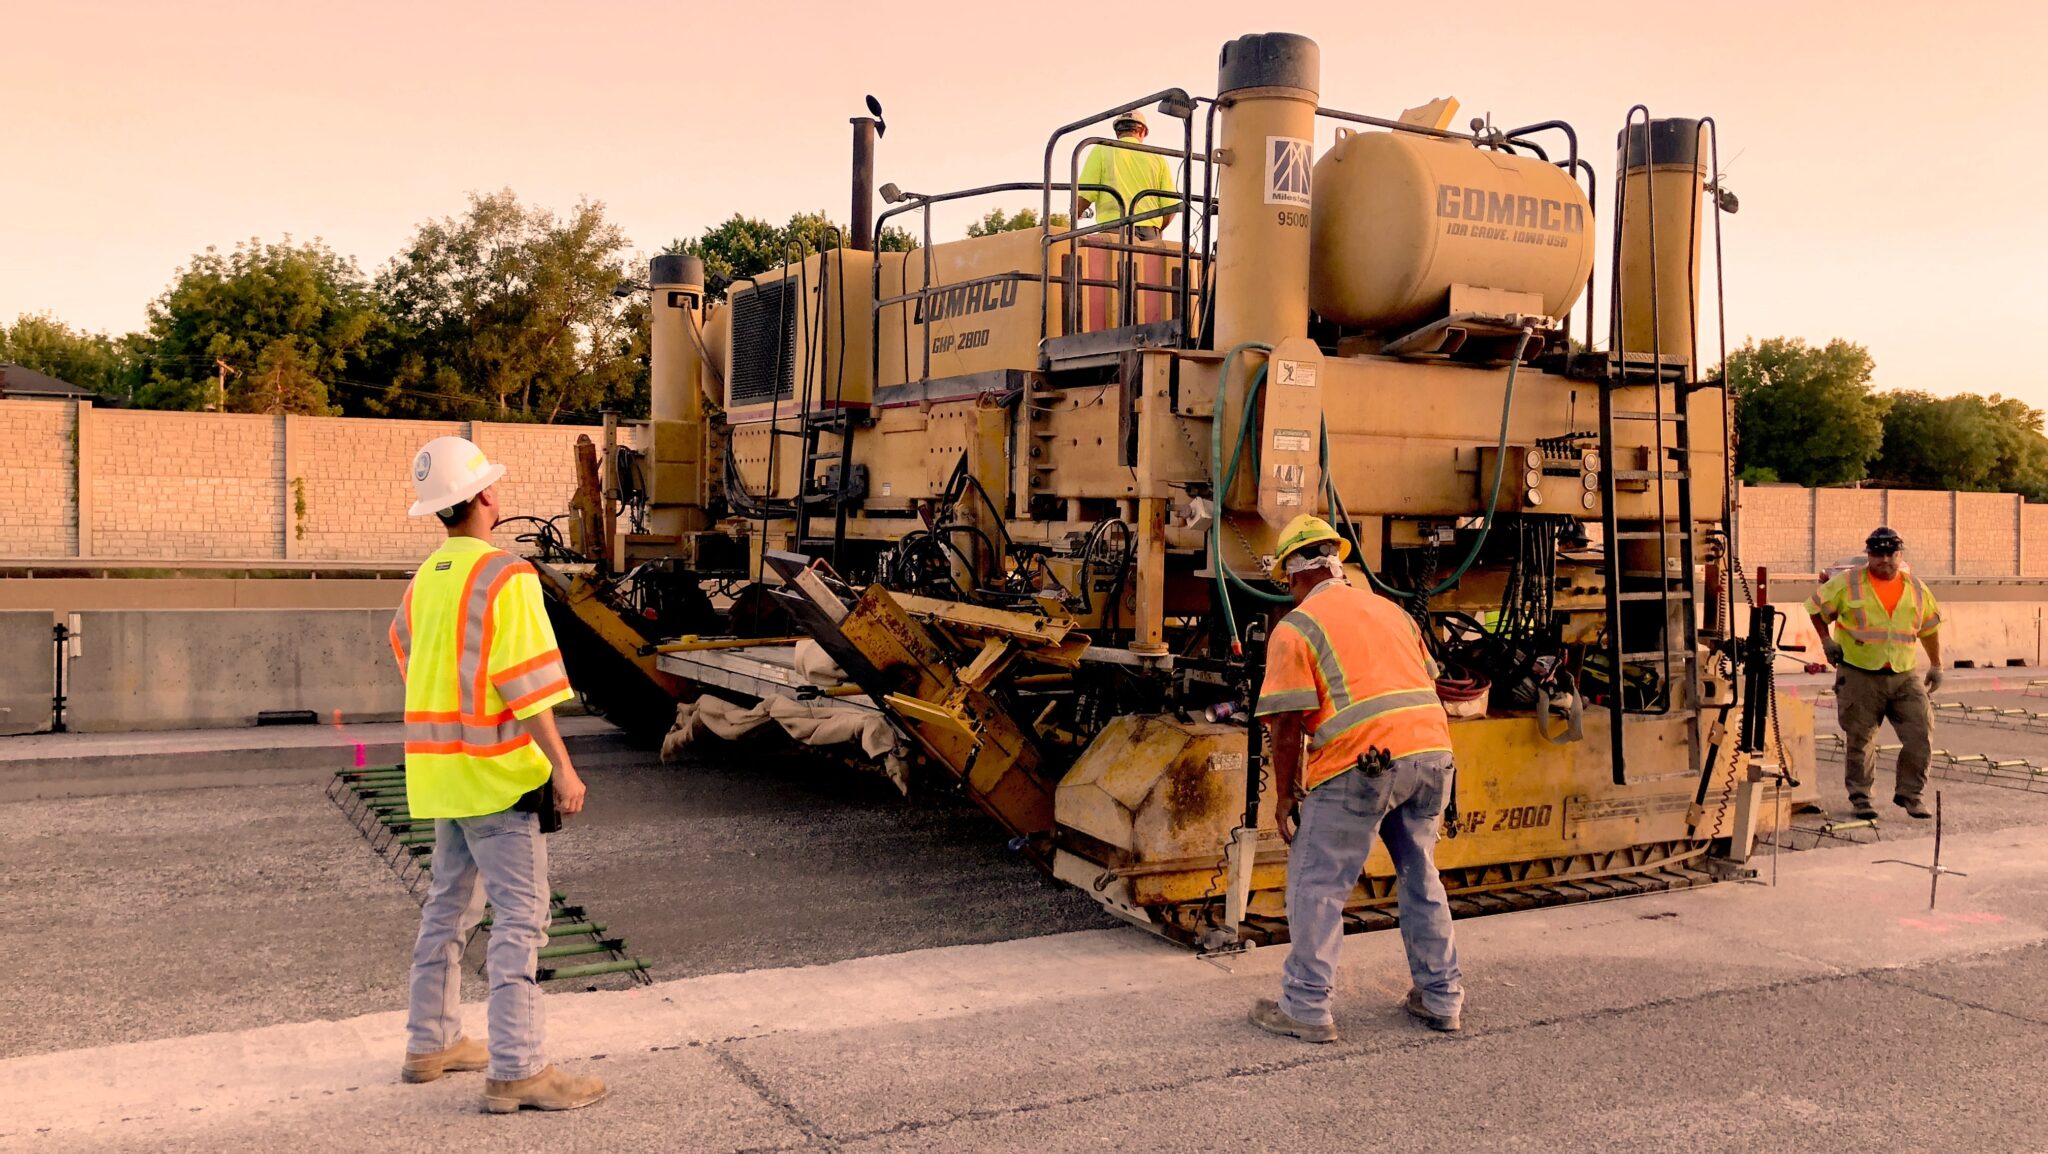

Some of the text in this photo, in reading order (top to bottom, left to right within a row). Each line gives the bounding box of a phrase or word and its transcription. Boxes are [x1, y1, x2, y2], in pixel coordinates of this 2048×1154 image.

[1437, 184, 1583, 234] GOMACO
[1446, 222, 1468, 237] IDA
[932, 329, 990, 354] GHP 2800
[1443, 804, 1553, 833] HP 2800
